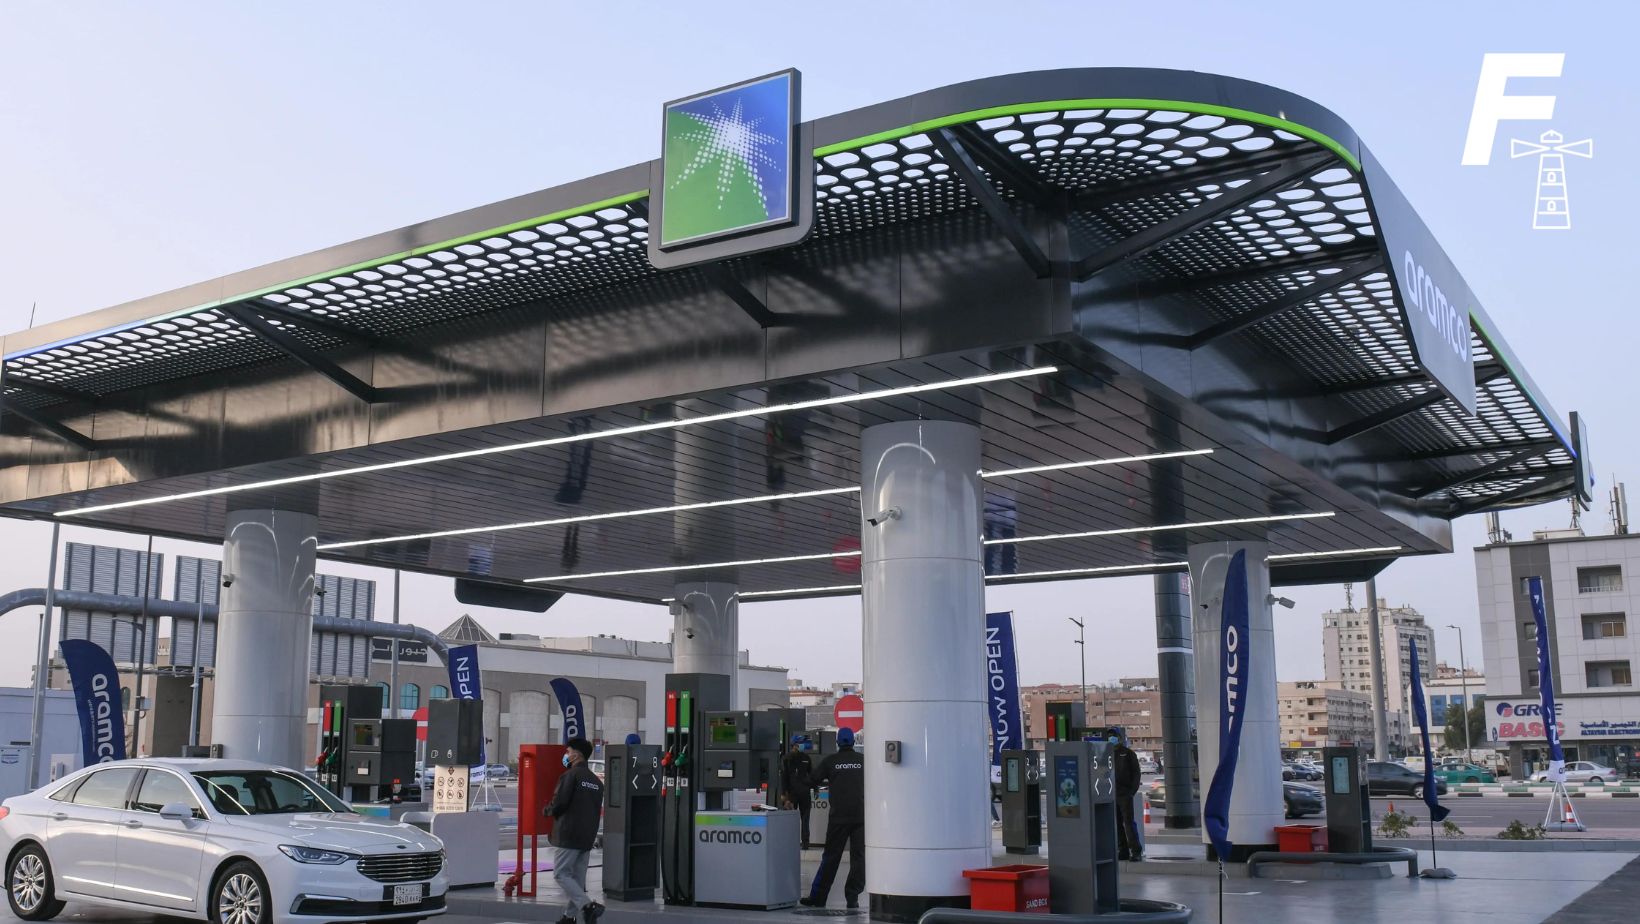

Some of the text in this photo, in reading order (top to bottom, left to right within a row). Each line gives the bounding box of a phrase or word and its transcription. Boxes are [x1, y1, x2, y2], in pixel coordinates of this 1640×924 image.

[1405, 250, 1467, 362] aramco
[986, 627, 1005, 692] OPEN
[1226, 625, 1238, 734] mco
[1514, 703, 1563, 716] GRE
[566, 705, 578, 738] ara
[632, 756, 658, 768] 7 8
[1093, 756, 1113, 770] 5 6
[581, 781, 599, 790] aramco
[699, 829, 762, 845] aramco
